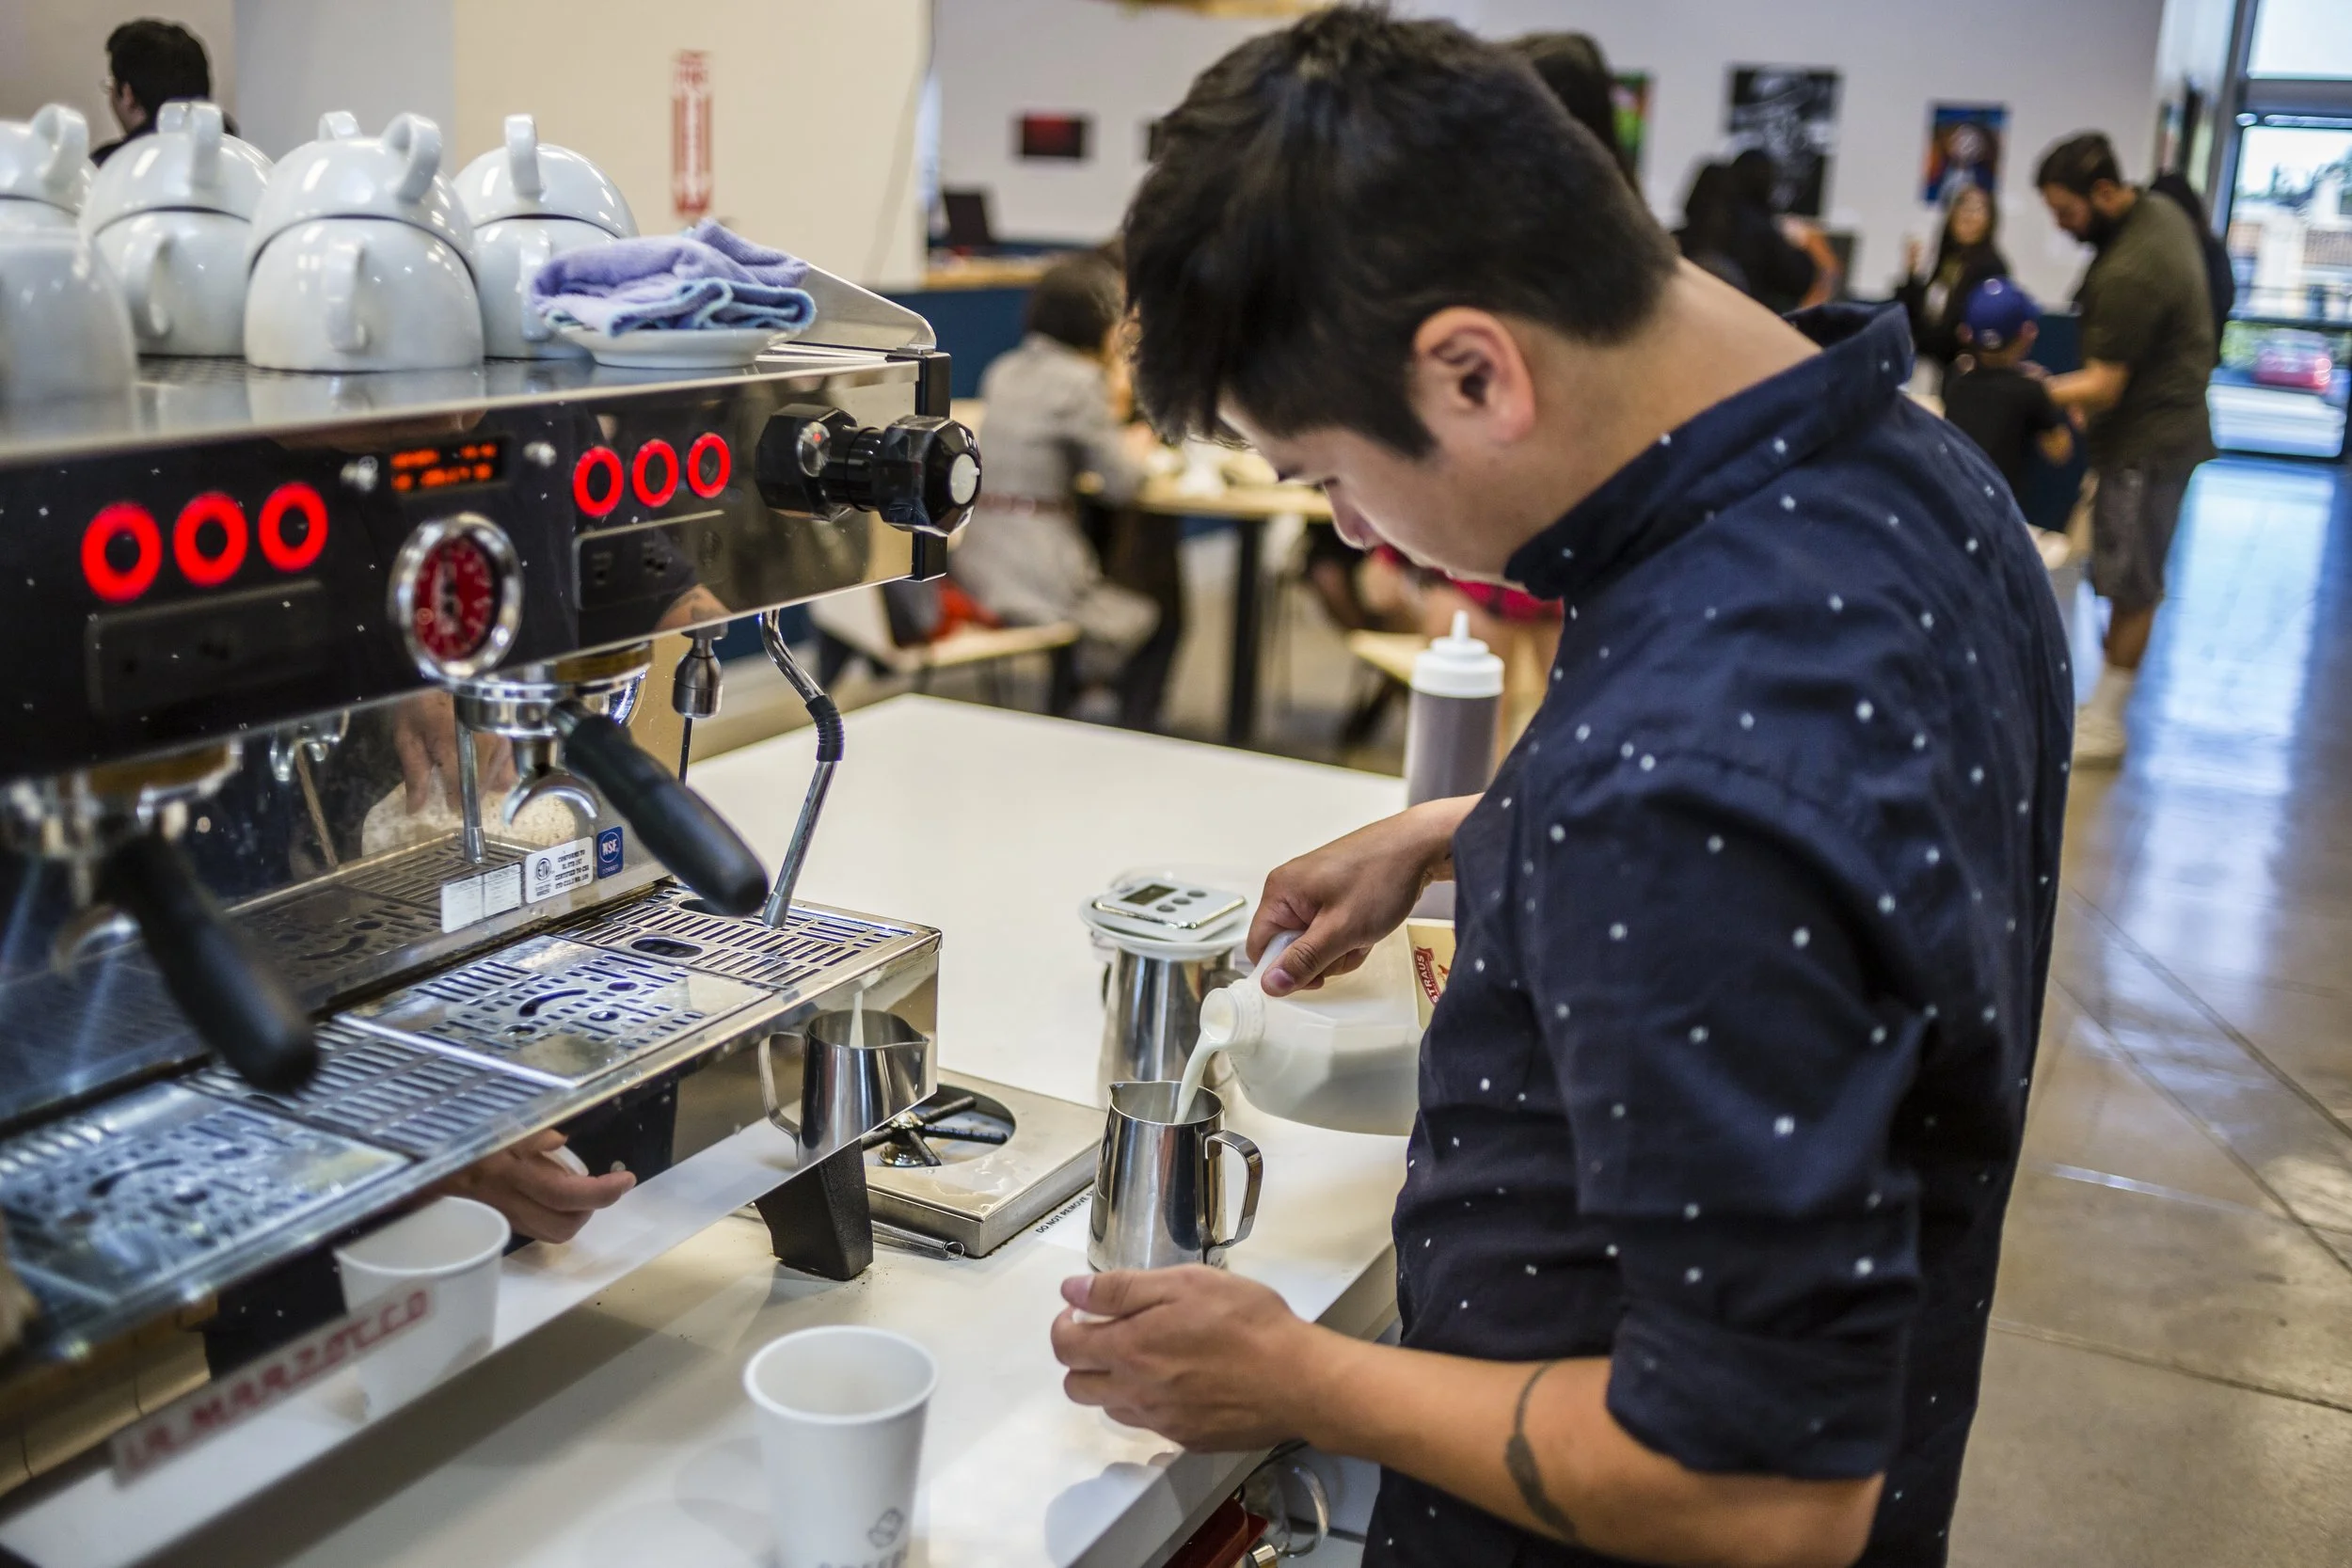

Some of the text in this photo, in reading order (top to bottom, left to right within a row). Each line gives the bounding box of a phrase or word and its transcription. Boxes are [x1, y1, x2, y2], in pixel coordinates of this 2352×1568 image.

[602, 839, 617, 856] NSF
[1417, 954, 1439, 1004] STRAUS
[1036, 1225, 1049, 1233] DO
[1046, 1214, 1062, 1225] NOT
[1060, 1196, 1088, 1216] REMOVE
[191, 1290, 428, 1429] MARZOCCO
